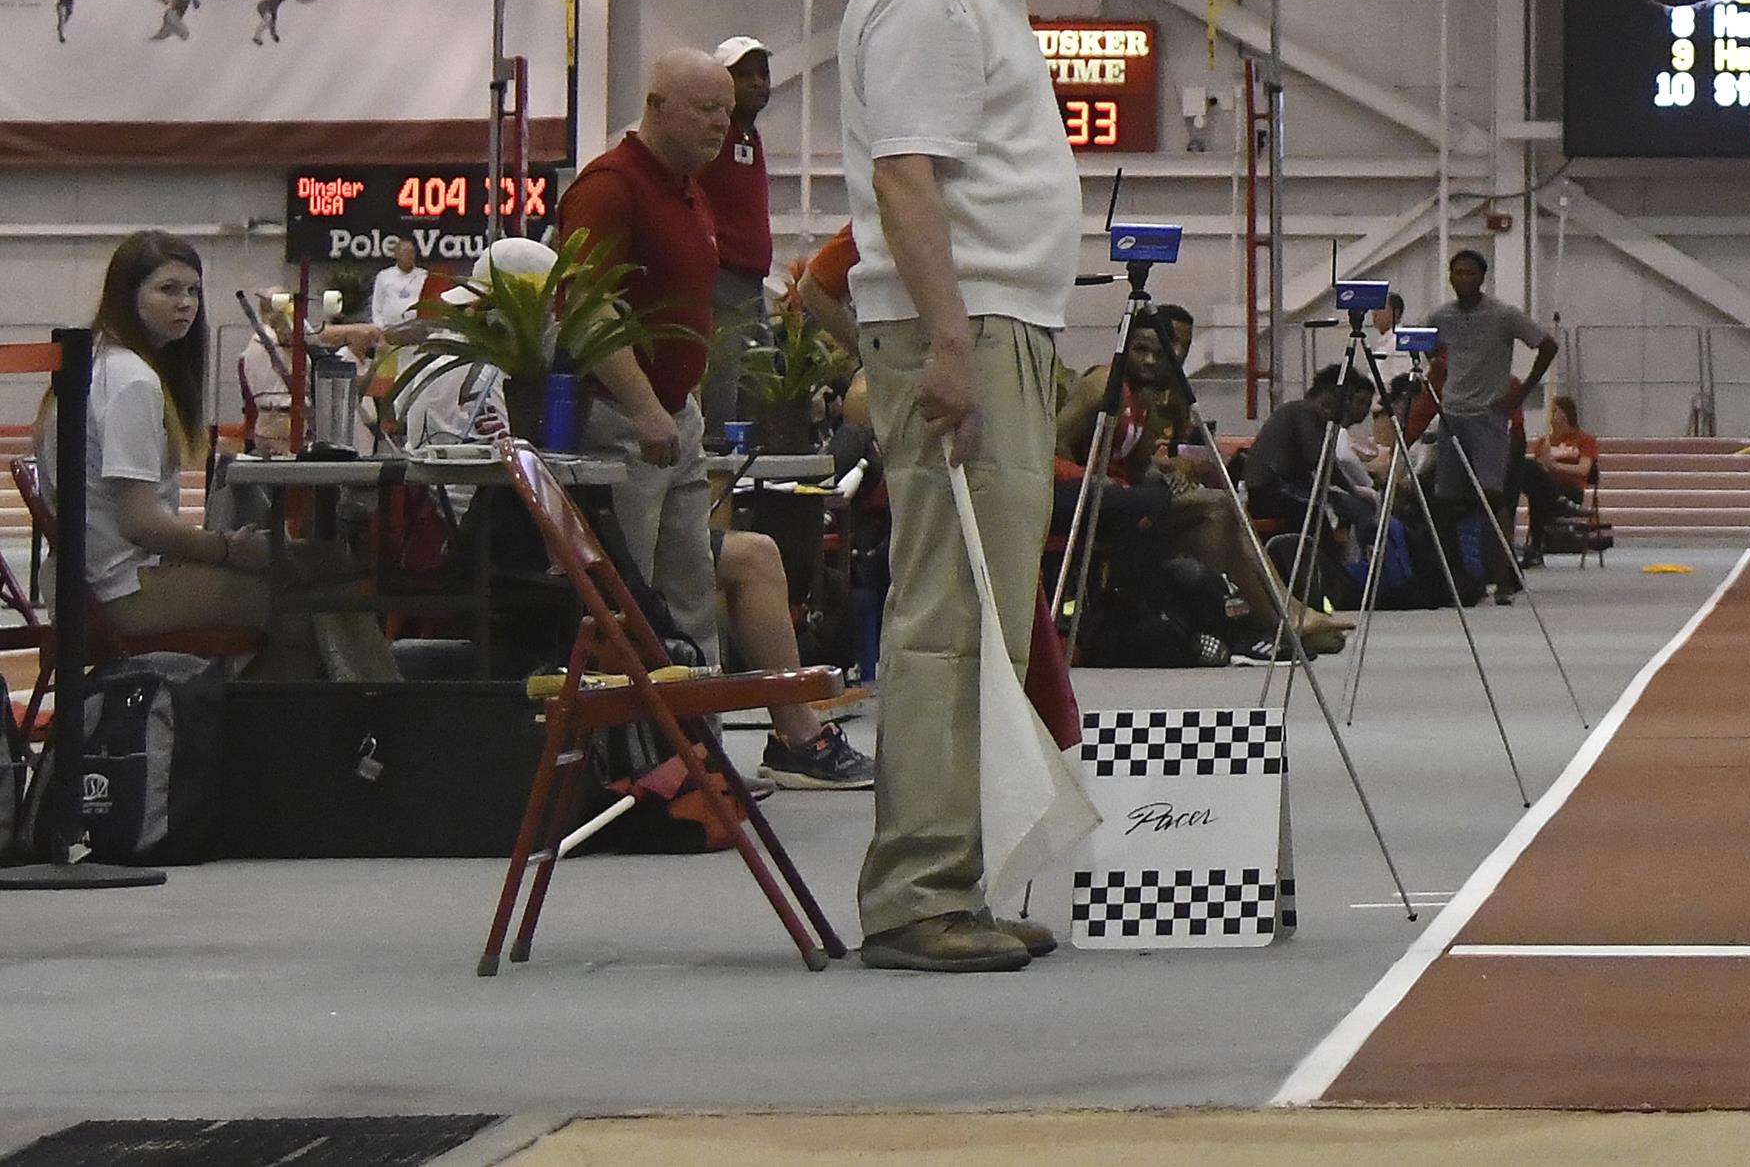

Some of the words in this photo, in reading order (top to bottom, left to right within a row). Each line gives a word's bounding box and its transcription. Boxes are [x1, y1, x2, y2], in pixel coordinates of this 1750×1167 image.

[1033, 30, 1149, 57] USKER
[1671, 38, 1695, 71] 9
[1654, 71, 1695, 107] 10
[297, 177, 364, 200] Dingler
[397, 177, 467, 216] 4.04
[308, 196, 345, 216] UGA
[329, 228, 401, 259] Pole
[1125, 802, 1219, 835] Pacer
